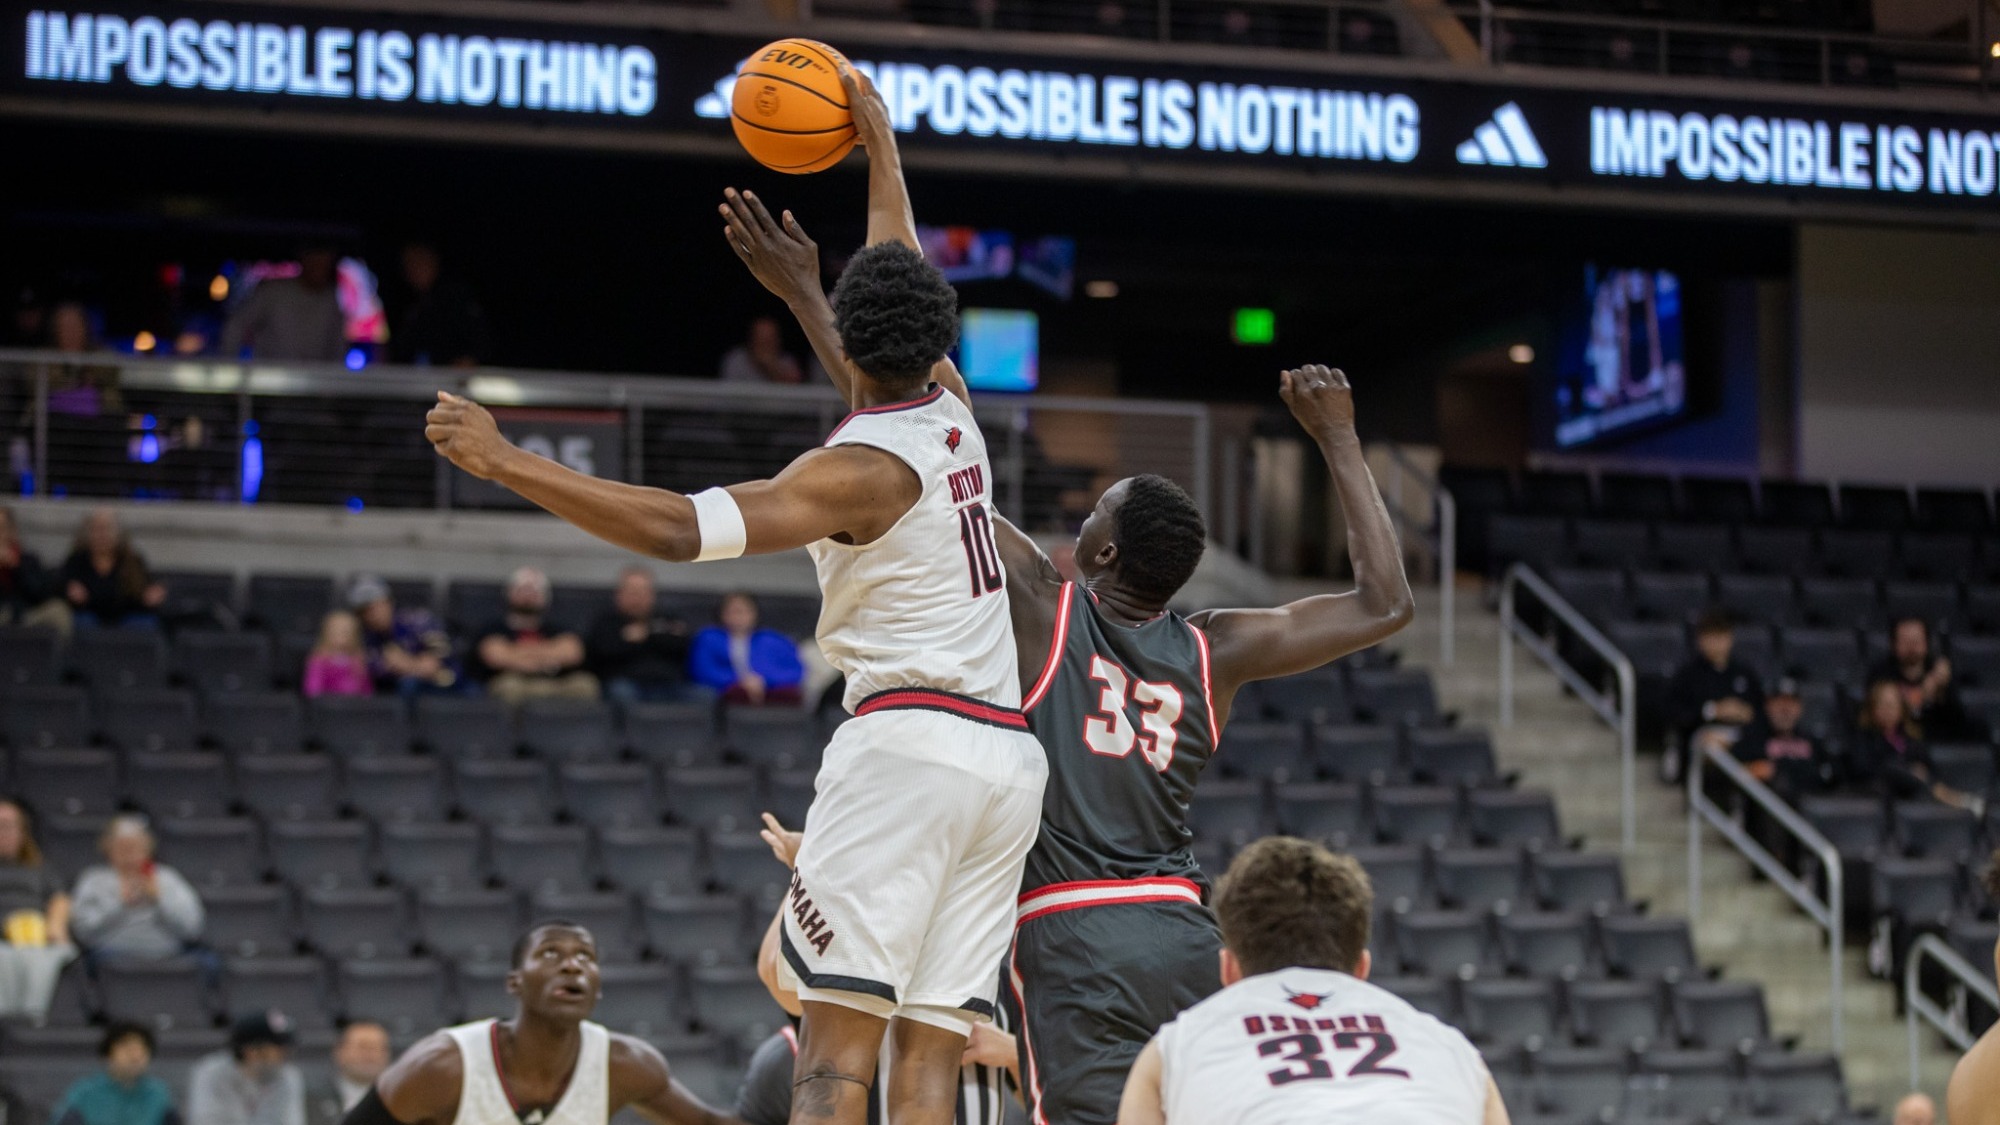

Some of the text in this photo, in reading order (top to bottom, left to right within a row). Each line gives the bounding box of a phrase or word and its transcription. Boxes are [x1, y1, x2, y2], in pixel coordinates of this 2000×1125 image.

[25, 10, 658, 116] IMPOSSIBLE IS NOTHING
[1142, 78, 1195, 149] IS
[1198, 81, 1419, 163] NOTHING
[1590, 106, 1872, 189] IMPOSSIBLE
[1876, 124, 1924, 192] IS
[958, 502, 1002, 598] 10
[1082, 652, 1184, 773] 33
[1257, 1032, 1413, 1086] 32
